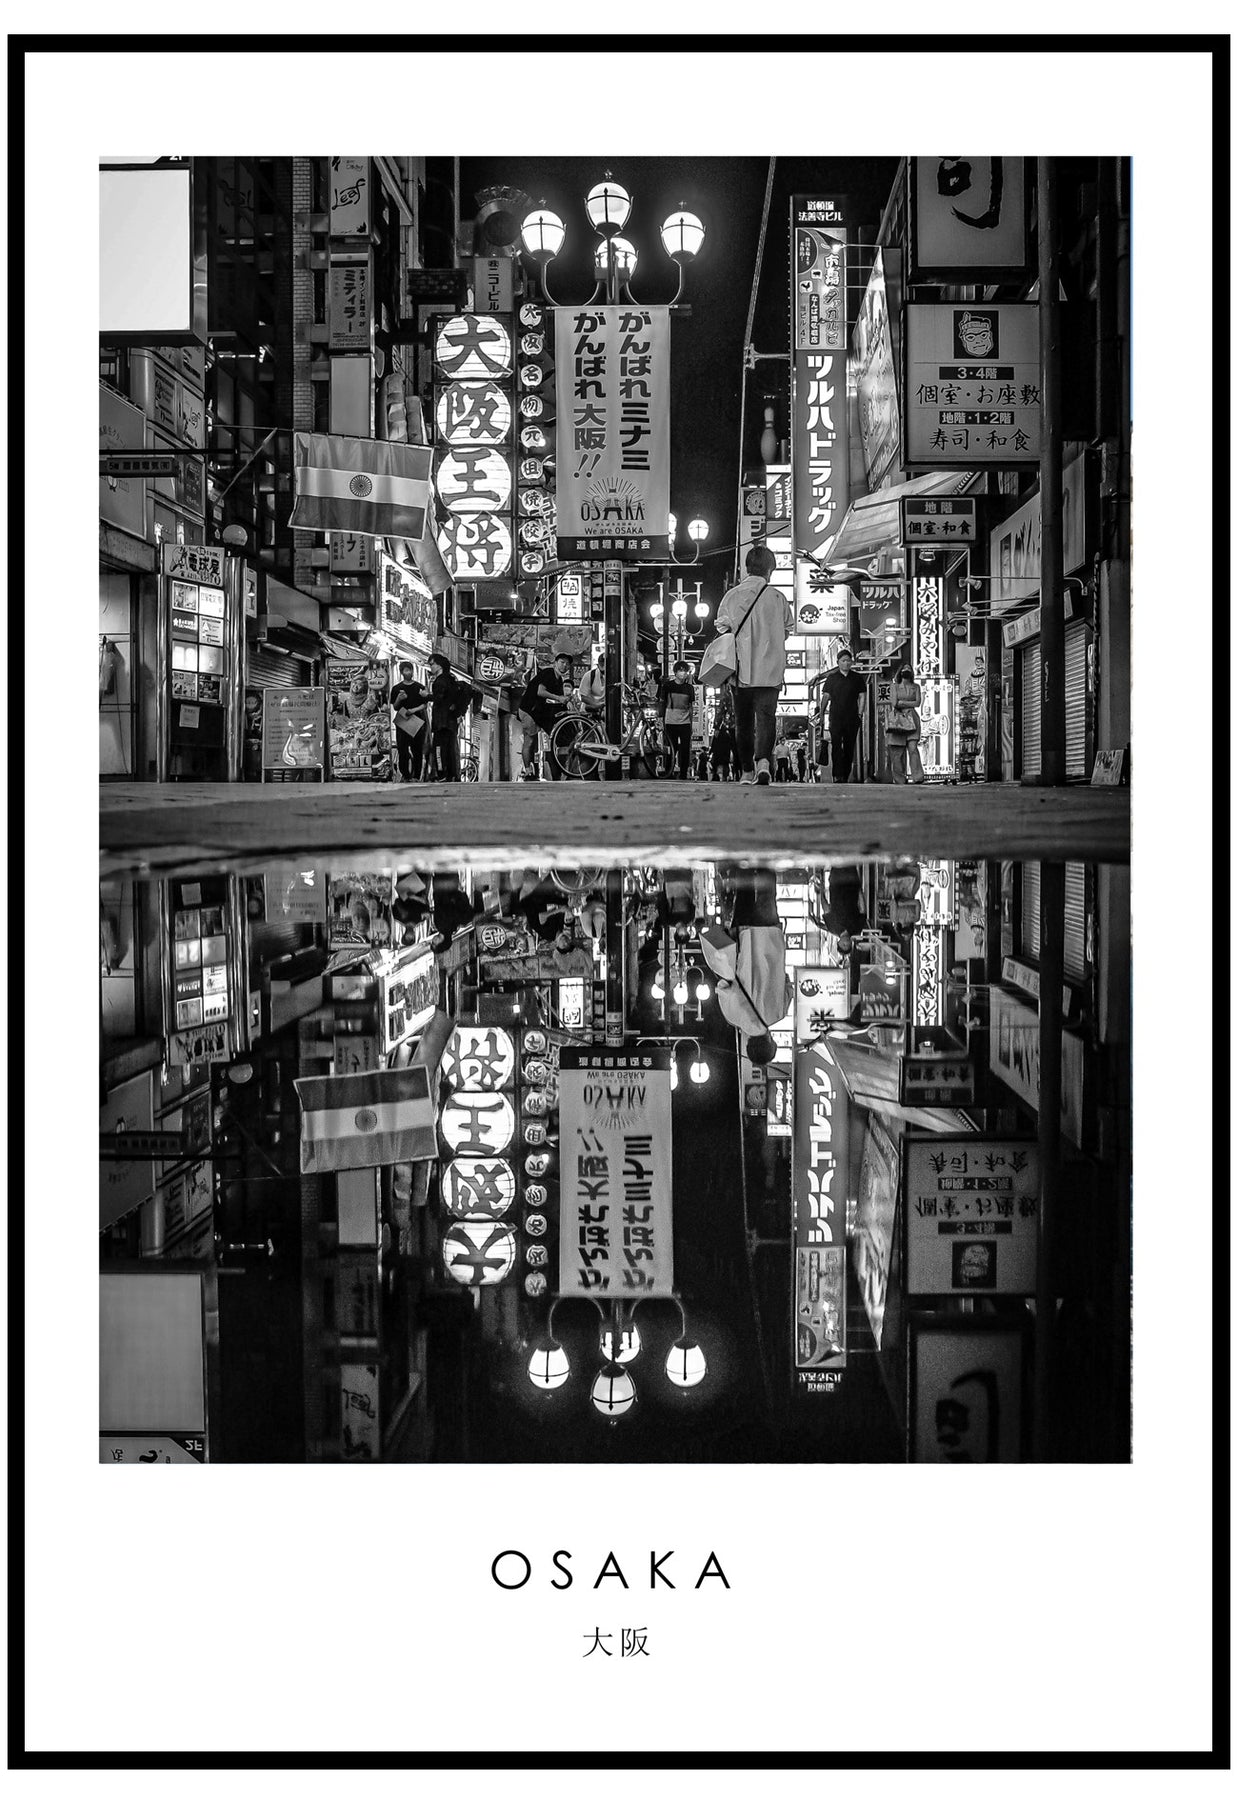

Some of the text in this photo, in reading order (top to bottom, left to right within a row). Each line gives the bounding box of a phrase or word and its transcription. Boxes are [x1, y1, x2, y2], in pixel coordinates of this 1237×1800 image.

[798, 211, 843, 222] 法善寺ビル
[343, 269, 356, 333] ミティラー
[618, 311, 652, 471] がんばれミナミ
[441, 313, 514, 575] 大阪王将
[806, 355, 837, 534] ツルハドラッグ
[581, 489, 645, 521] OSAKA
[584, 527, 598, 535] We
[614, 527, 644, 535] OSAKA
[576, 539, 651, 550] 道頓堀商店会
[862, 586, 901, 599] ツルハ
[862, 601, 893, 610] ドラッグ
